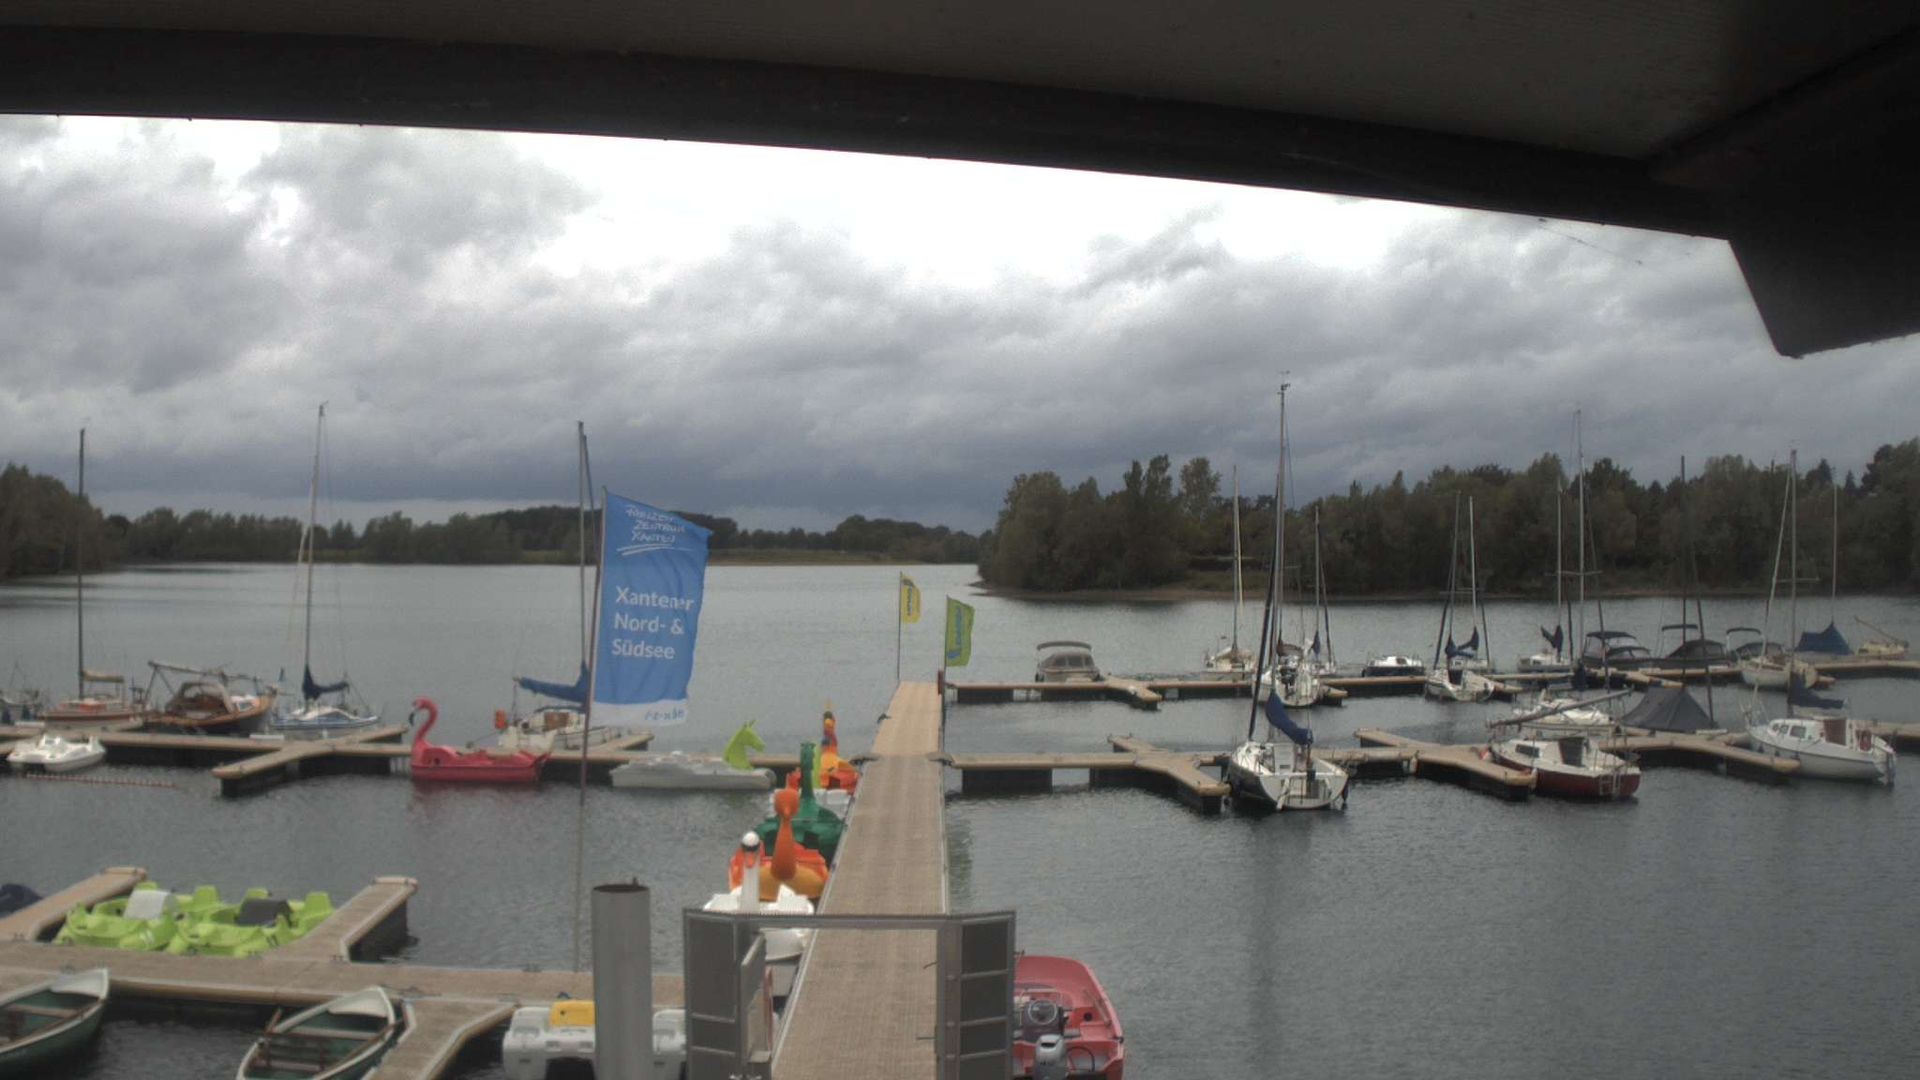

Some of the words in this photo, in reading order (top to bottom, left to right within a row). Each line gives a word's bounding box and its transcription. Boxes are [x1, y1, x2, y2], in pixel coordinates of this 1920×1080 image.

[615, 585, 694, 610] Xantener
[614, 612, 666, 632] Nord-
[670, 617, 684, 635] &
[611, 638, 676, 660] Südsee
